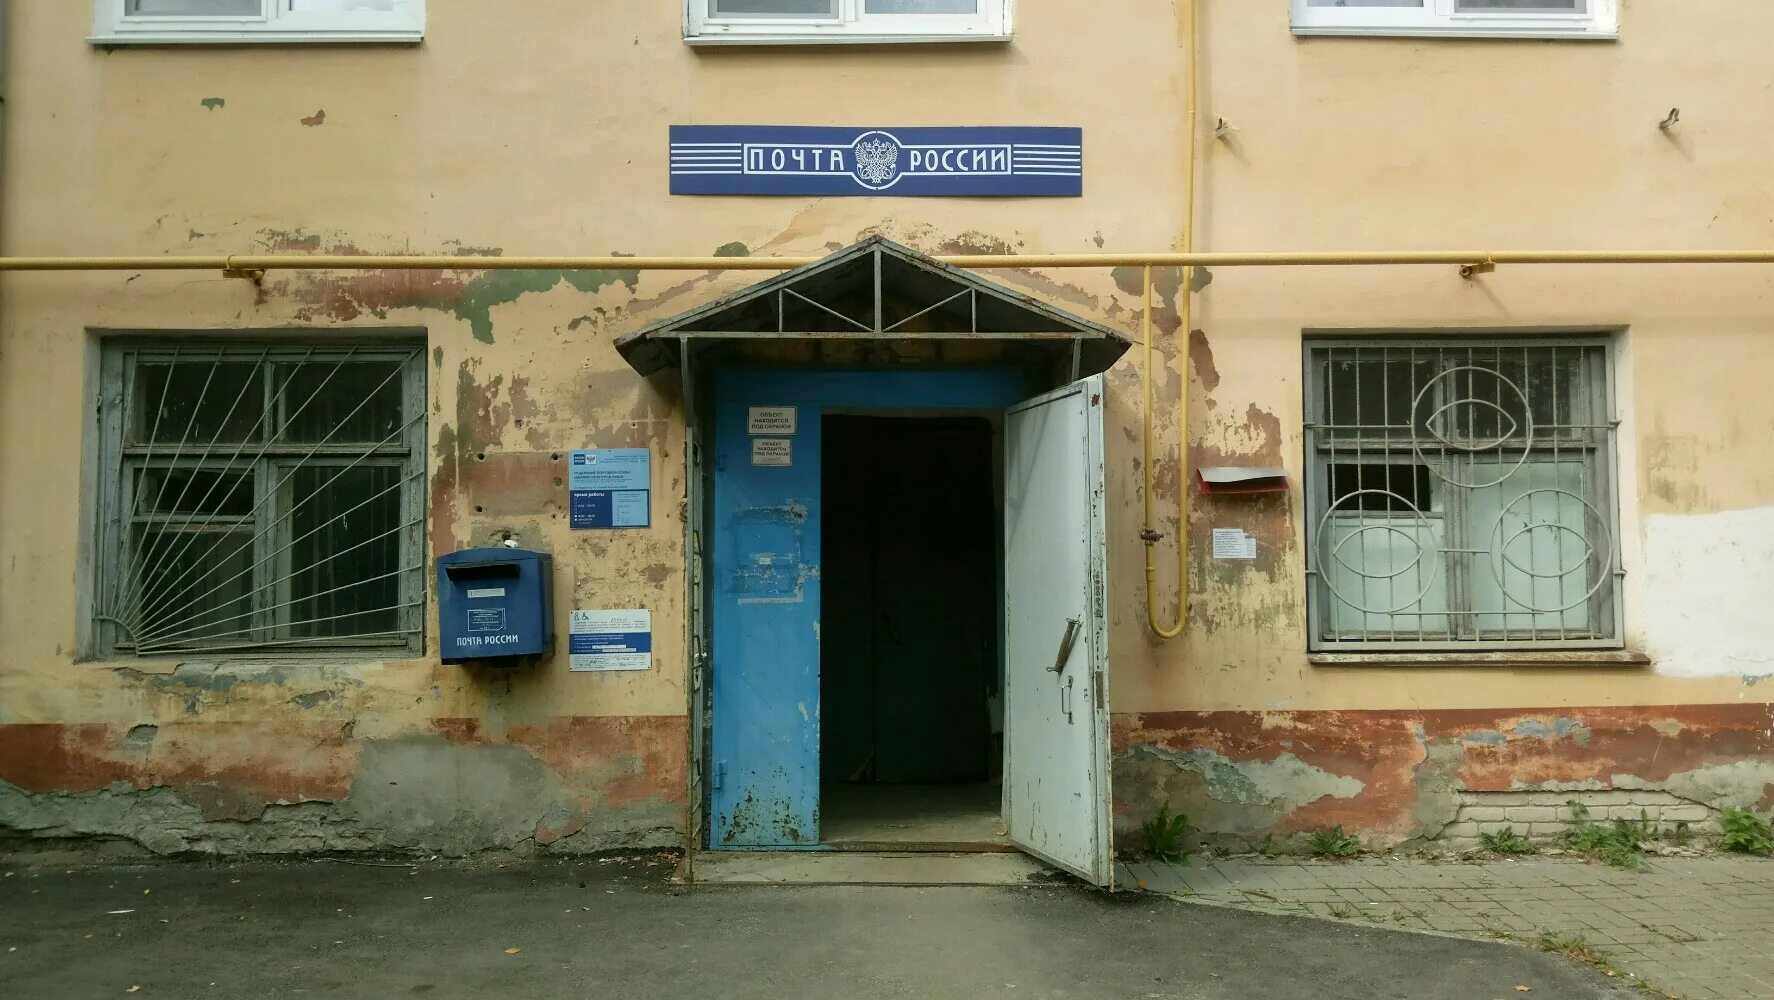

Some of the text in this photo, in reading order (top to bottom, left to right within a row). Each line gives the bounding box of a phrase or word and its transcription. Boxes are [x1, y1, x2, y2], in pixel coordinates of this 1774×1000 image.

[749, 148, 1007, 172] ПОЧТА РОССИИ
[456, 634, 519, 646] ПОЧТА РОССИИ
